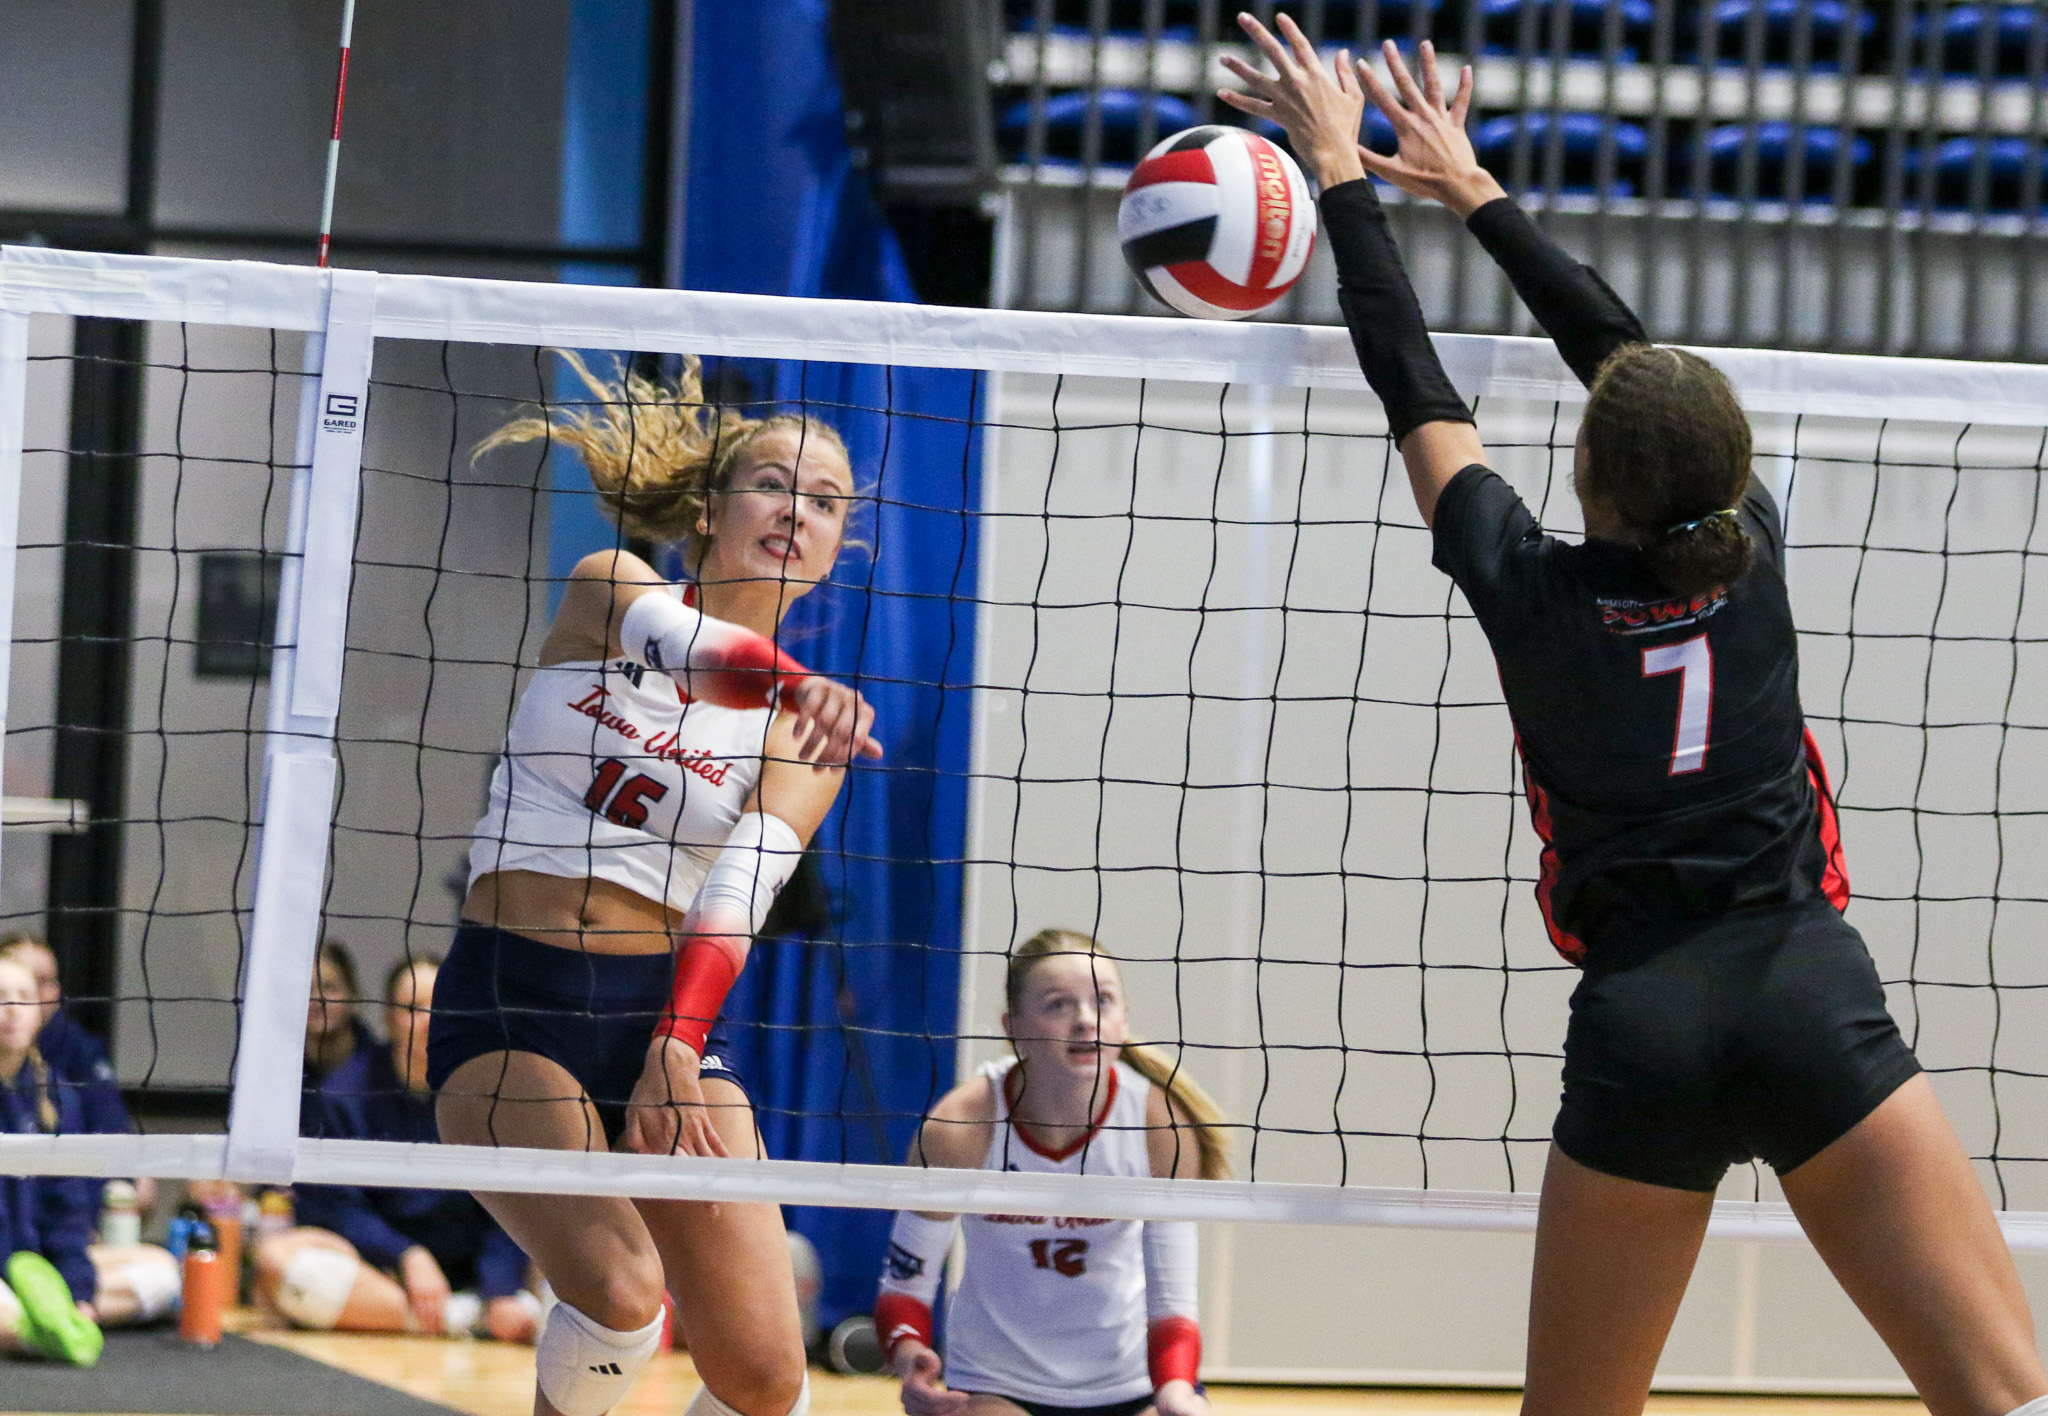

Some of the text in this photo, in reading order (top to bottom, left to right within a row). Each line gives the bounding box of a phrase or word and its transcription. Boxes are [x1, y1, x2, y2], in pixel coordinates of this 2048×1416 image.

[1258, 153, 1290, 261] molten
[323, 418, 357, 429] GARED
[567, 684, 733, 786] Iowa United
[1641, 632, 1713, 776] 7
[584, 758, 669, 829] 16
[1028, 1238, 1089, 1278] 12
